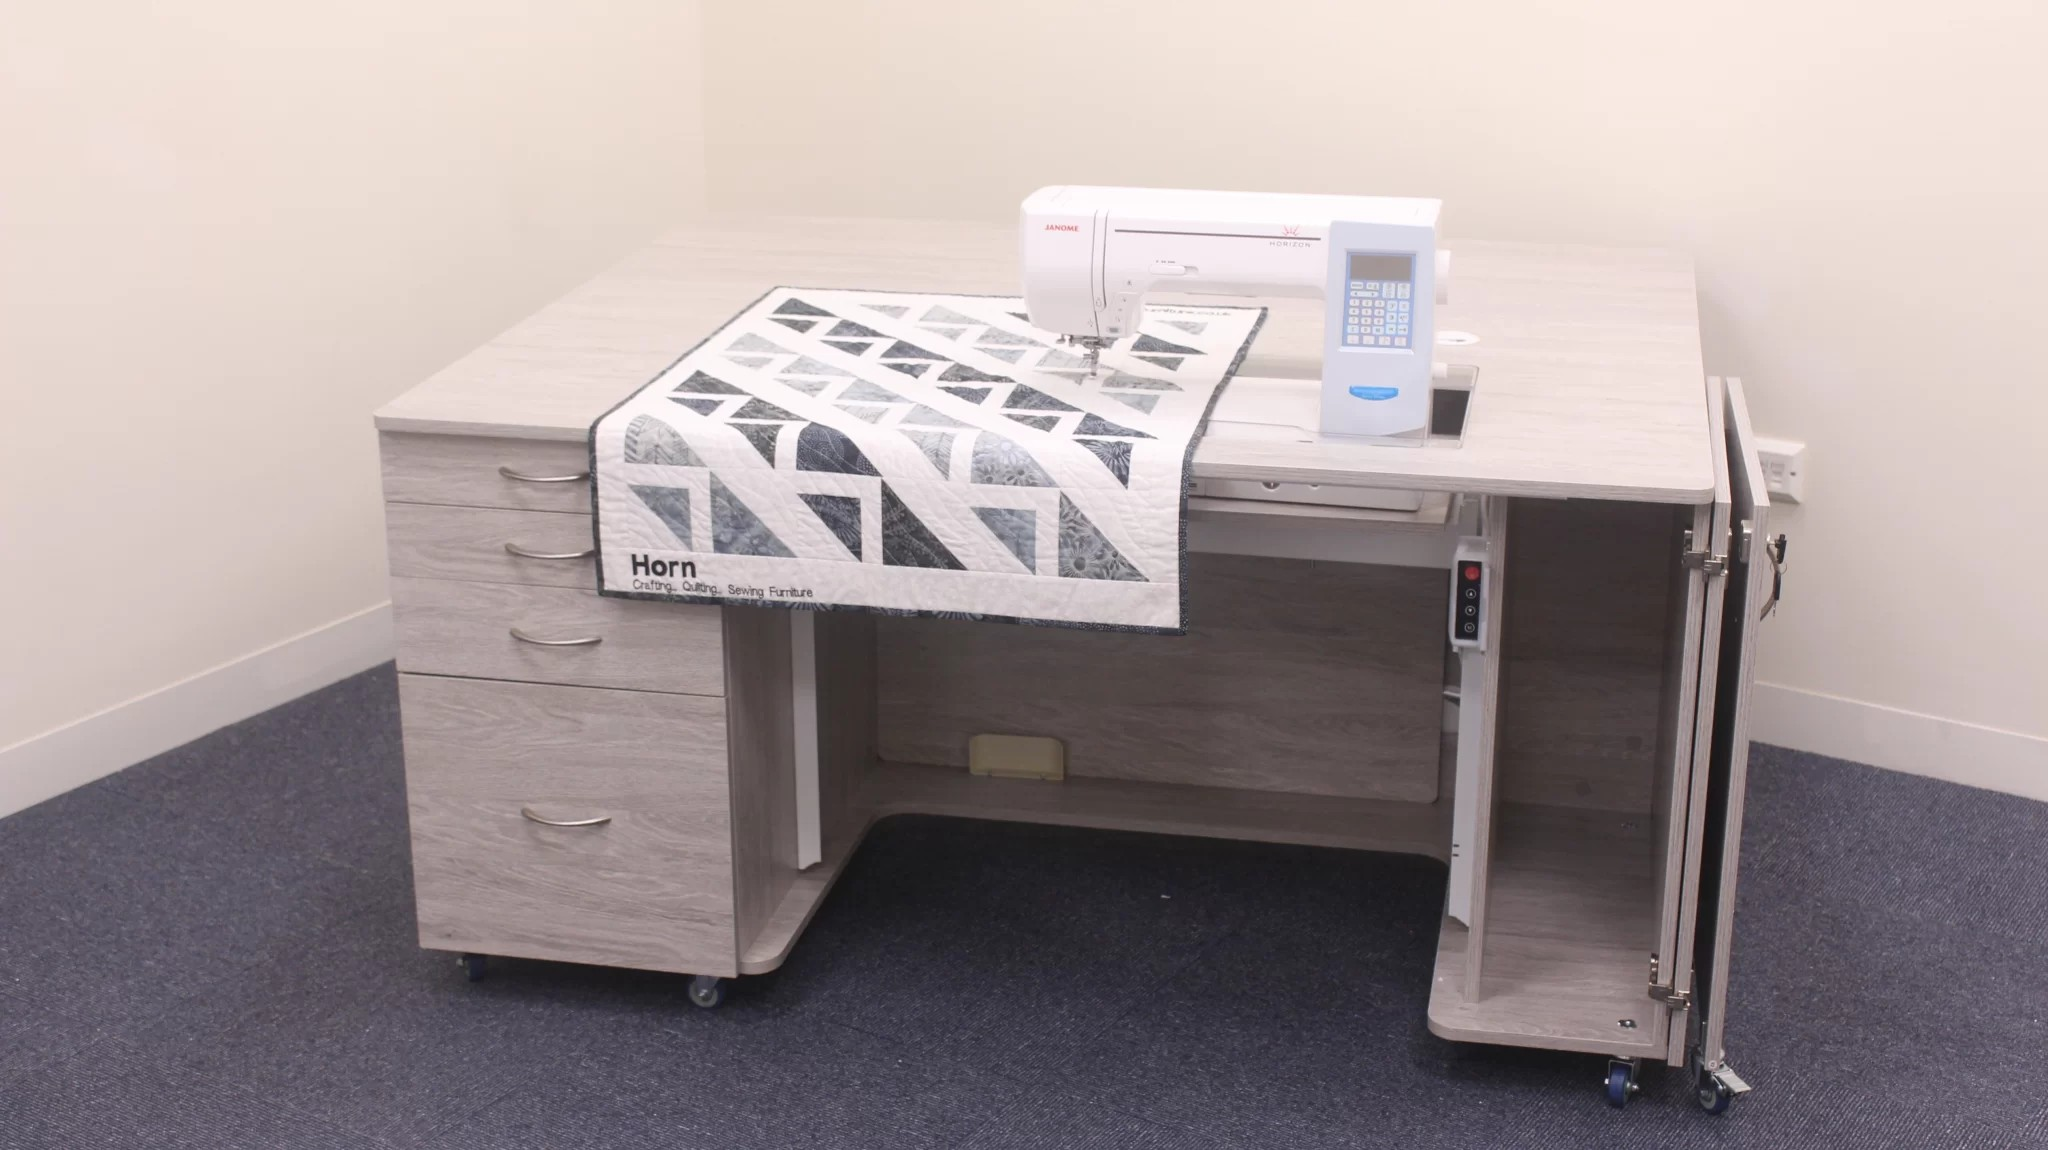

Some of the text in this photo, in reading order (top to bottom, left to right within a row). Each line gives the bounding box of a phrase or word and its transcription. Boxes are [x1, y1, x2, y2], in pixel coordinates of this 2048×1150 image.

[1045, 224, 1080, 232] JANOME
[631, 553, 697, 578] Horn
[728, 584, 764, 599] Sewing
[769, 586, 814, 598] Furniture
